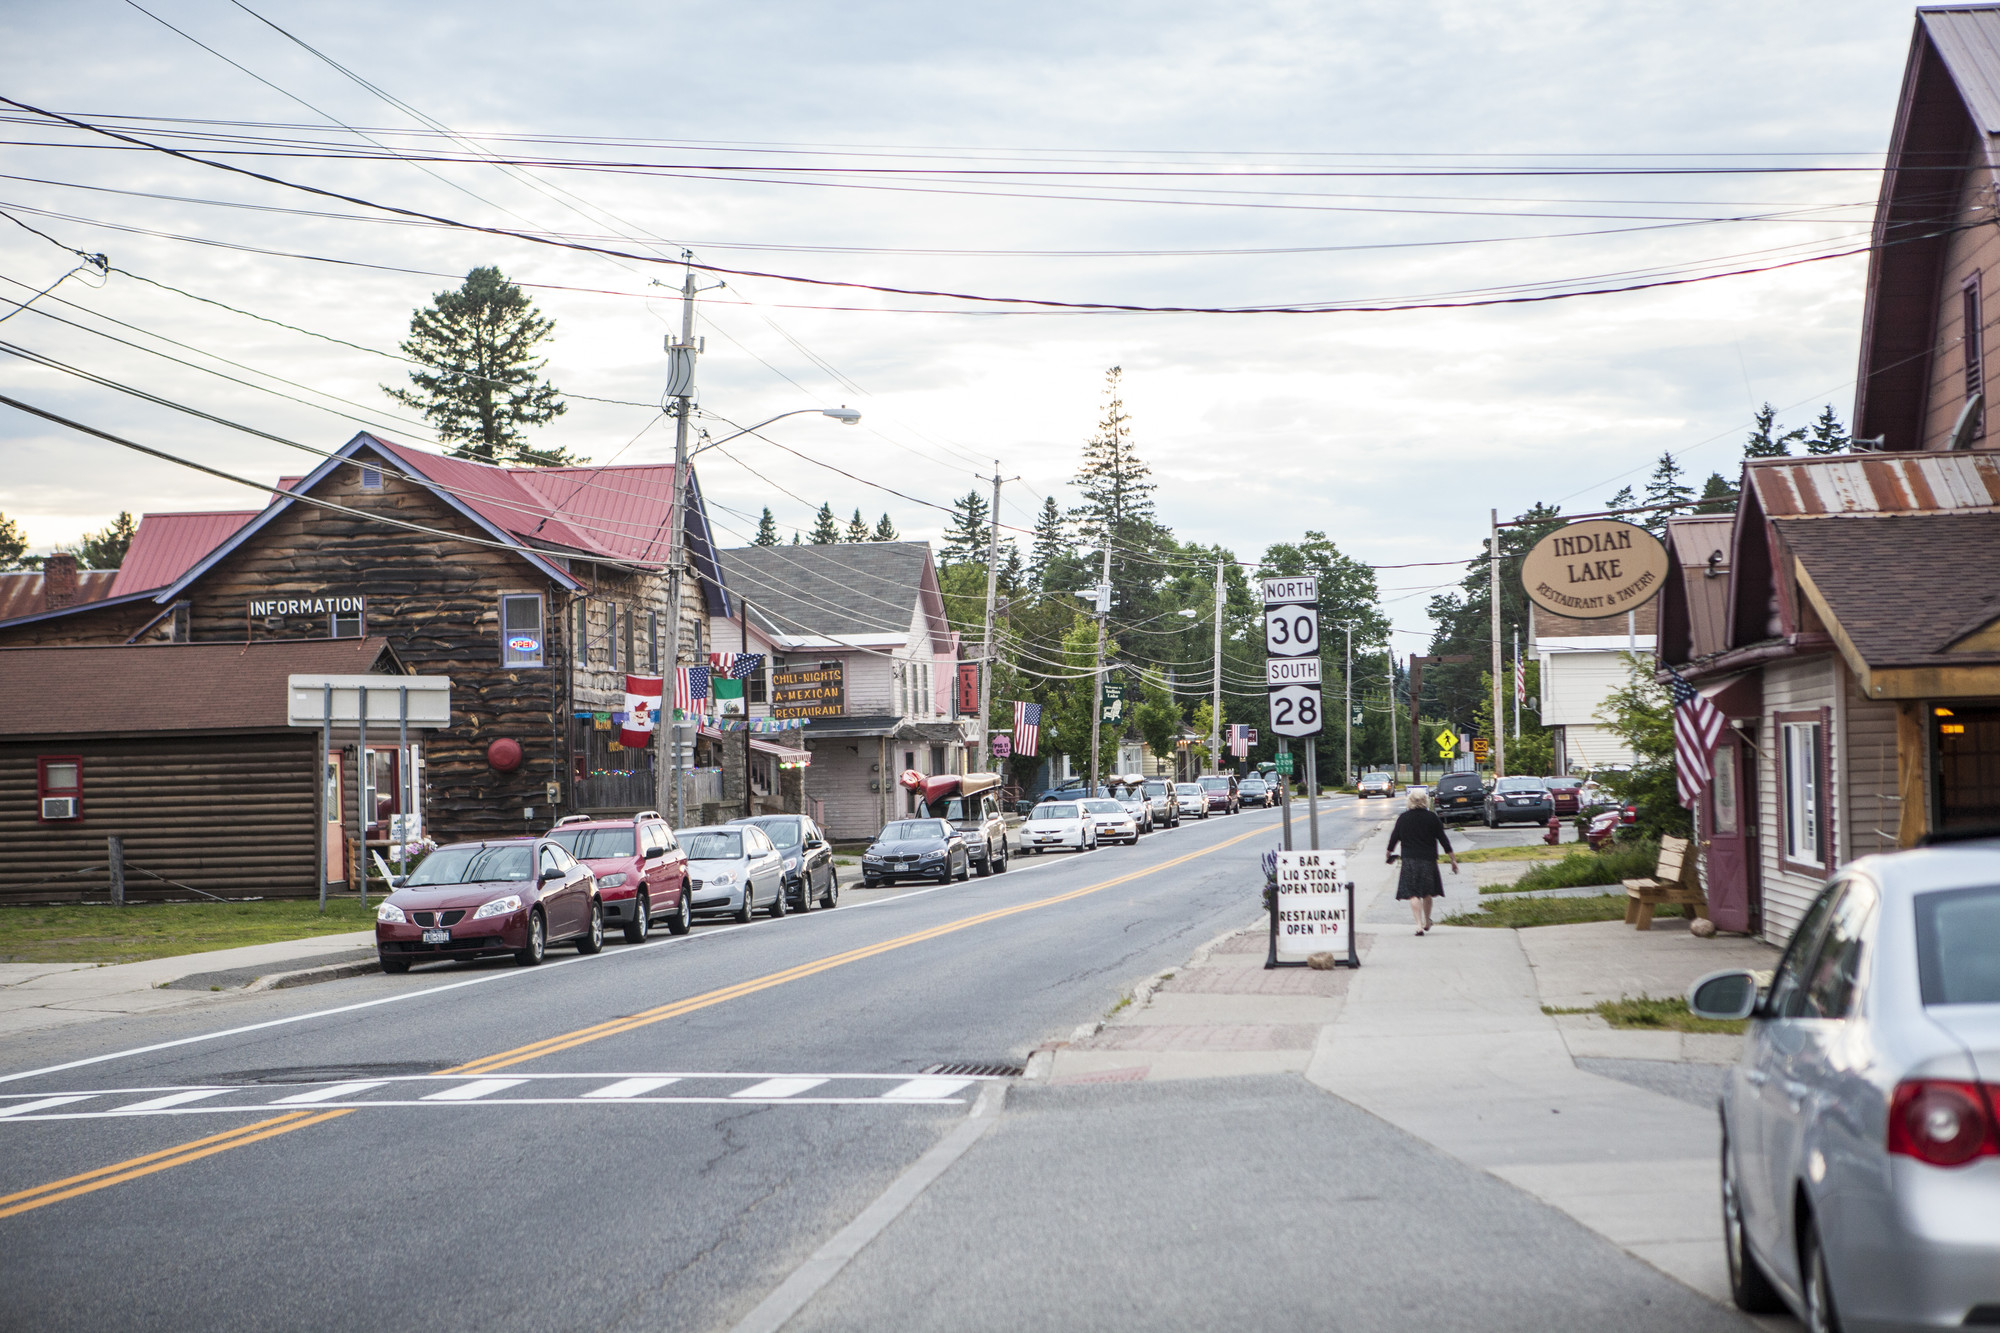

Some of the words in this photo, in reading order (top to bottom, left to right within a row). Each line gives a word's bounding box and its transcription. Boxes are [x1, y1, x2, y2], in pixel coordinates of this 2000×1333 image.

[1553, 530, 1632, 557] INDIAN
[1567, 559, 1623, 583] LAKE
[1267, 582, 1314, 598] NORTH
[1536, 582, 1604, 609] RESTAURANT
[1605, 594, 1617, 606] &
[1616, 570, 1656, 602] TAVERN
[250, 597, 363, 616] INFORMATION
[1271, 616, 1313, 645] 30
[511, 640, 534, 649] OPEN
[773, 669, 842, 685] CHILI-NIGHTS
[1271, 663, 1317, 679] SOUTH
[775, 688, 839, 702] A-MEXICAN
[775, 705, 843, 719] RESTAURANT
[1274, 696, 1317, 725] 28
[1299, 855, 1320, 867] BAR
[1283, 870, 1299, 880] LIQ
[1303, 869, 1337, 880] STORE
[1280, 883, 1307, 894] OPEN
[1310, 882, 1343, 893] TODAY
[1280, 909, 1347, 922] RESTAURANT
[1287, 923, 1314, 935] OPEN
[1320, 923, 1338, 935] 11-9
